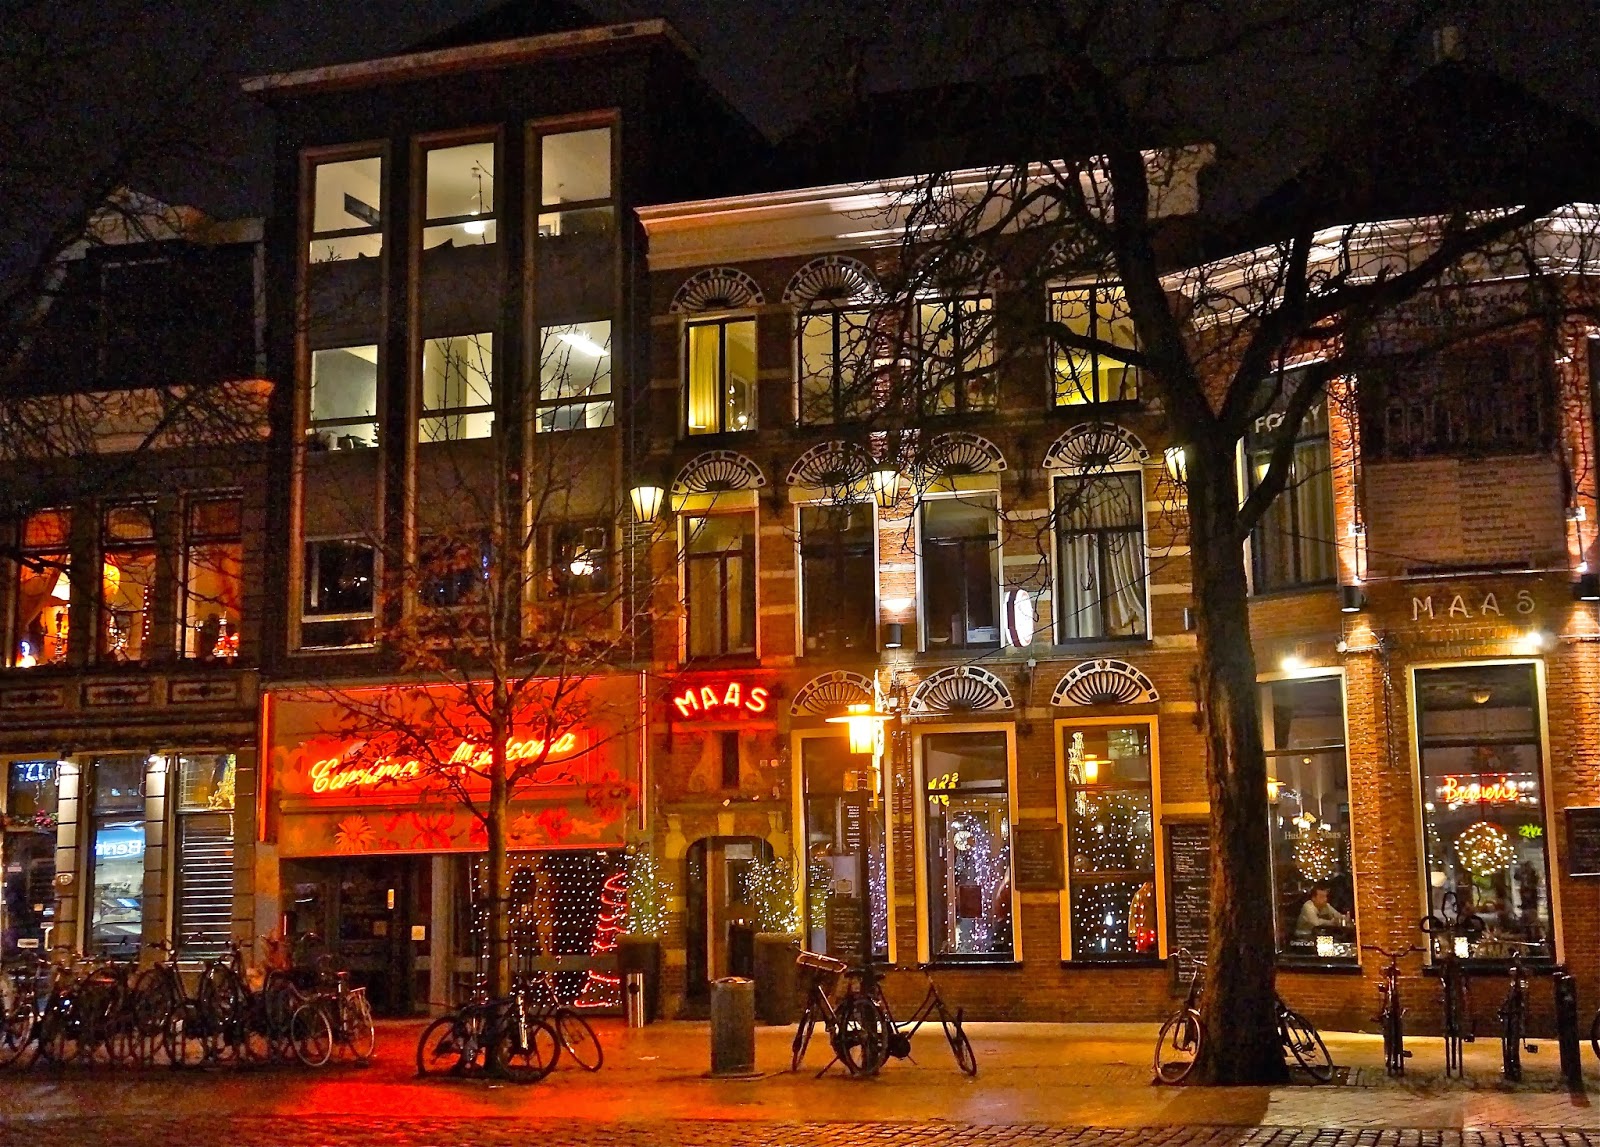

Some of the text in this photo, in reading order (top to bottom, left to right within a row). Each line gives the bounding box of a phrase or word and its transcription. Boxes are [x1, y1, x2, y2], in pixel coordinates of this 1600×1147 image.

[1412, 590, 1536, 621] MAAS
[673, 682, 769, 717] MAAS
[309, 732, 577, 793] Cantina Mexcana
